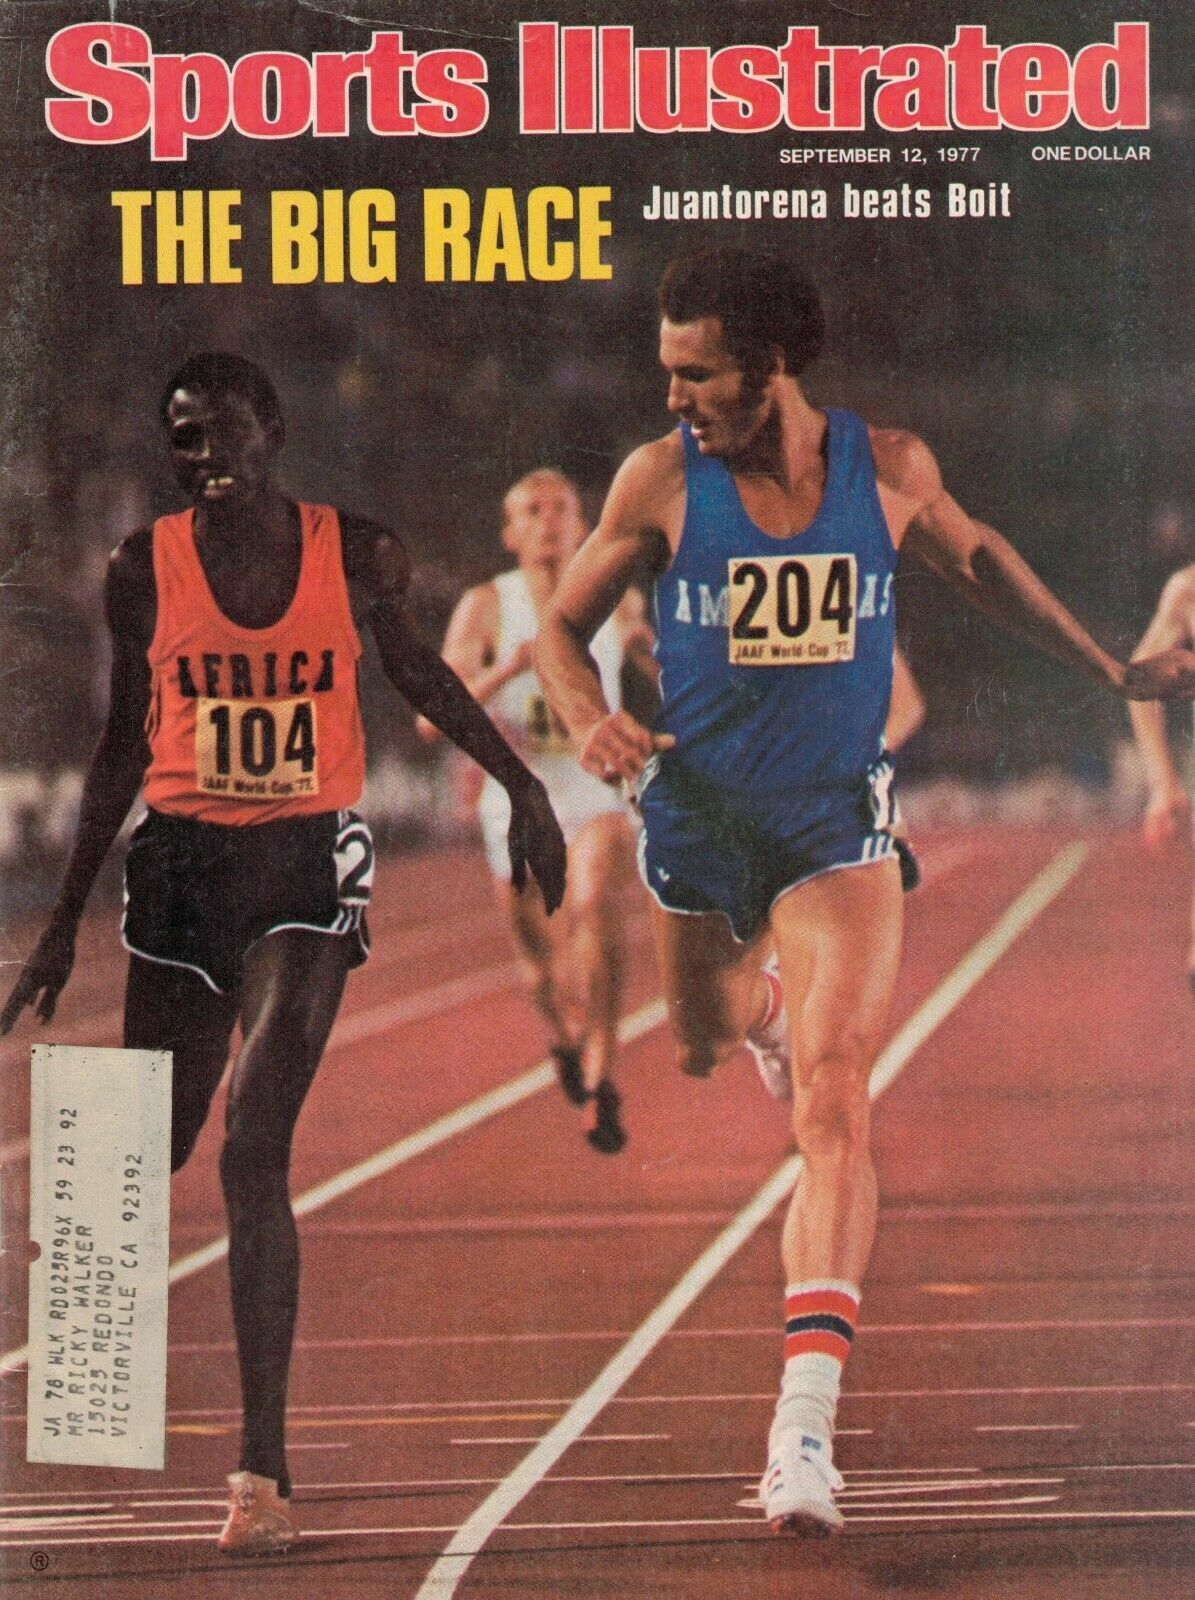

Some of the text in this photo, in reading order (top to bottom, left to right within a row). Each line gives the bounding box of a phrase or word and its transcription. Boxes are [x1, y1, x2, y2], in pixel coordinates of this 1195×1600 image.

[44, 21, 1151, 162] Sports Illustrated
[779, 147, 981, 165] SEPTEMBER 12, 1977
[1031, 146, 1151, 161] ONE DOLLAR
[111, 186, 613, 286] THE BIG RACE
[643, 182, 1011, 220] Juantorena beats Boit
[732, 557, 853, 640] 204
[209, 701, 316, 777] 104
[334, 829, 372, 900] 2
[59, 1108, 77, 1130] 92
[57, 1145, 75, 1167] 23
[66, 1225, 94, 1437] MR RICKY WALKER
[110, 1154, 142, 1437] VICTORVILLE CA 92392
[48, 1333, 65, 1365] WLK
[87, 1254, 115, 1436] 15025 REDONDO
[43, 1416, 62, 1437] JA
